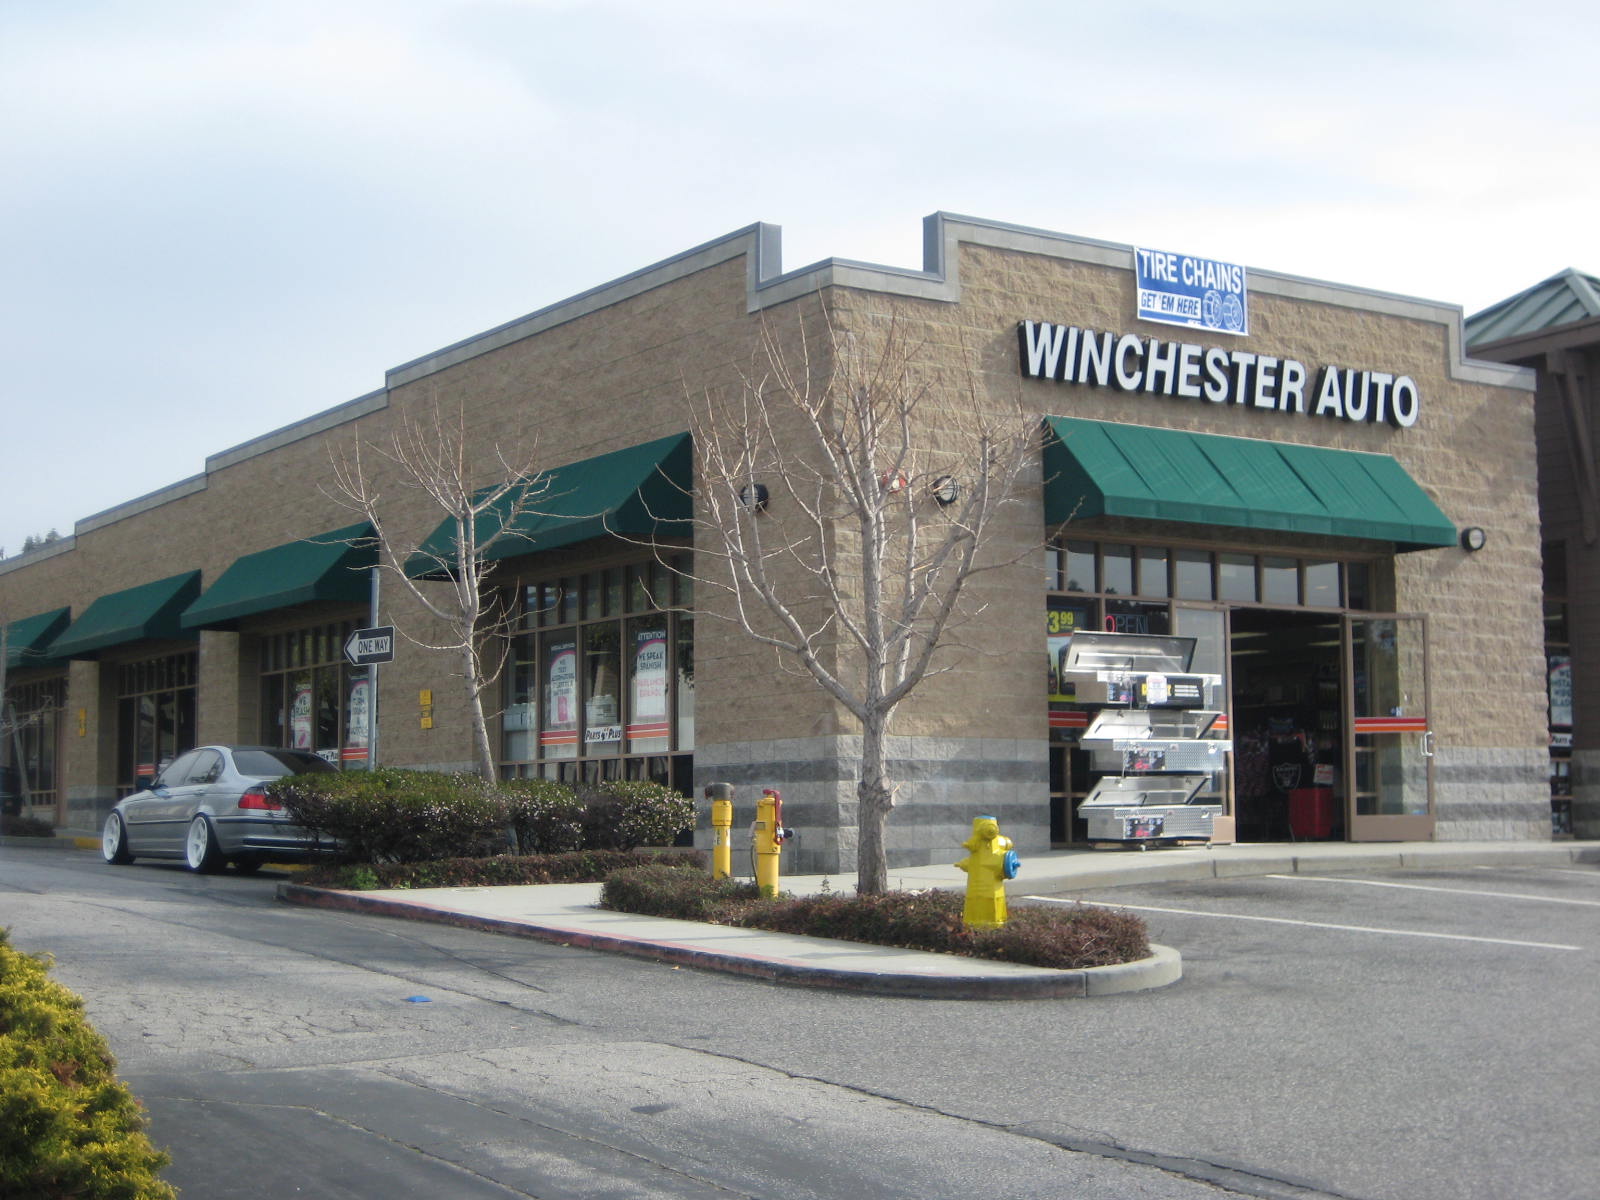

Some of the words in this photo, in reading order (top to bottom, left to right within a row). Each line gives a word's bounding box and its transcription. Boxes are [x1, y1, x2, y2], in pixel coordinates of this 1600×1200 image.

[1139, 250, 1178, 283] TIRE
[1182, 257, 1242, 294] CHAINS
[1141, 291, 1157, 309] GET
[1177, 297, 1199, 317] HERE
[1022, 319, 1306, 413] WINCHESTER
[1313, 365, 1420, 428] AUTO
[1105, 615, 1149, 633] OPEN
[358, 640, 373, 654] ONE
[375, 637, 388, 652] WAY
